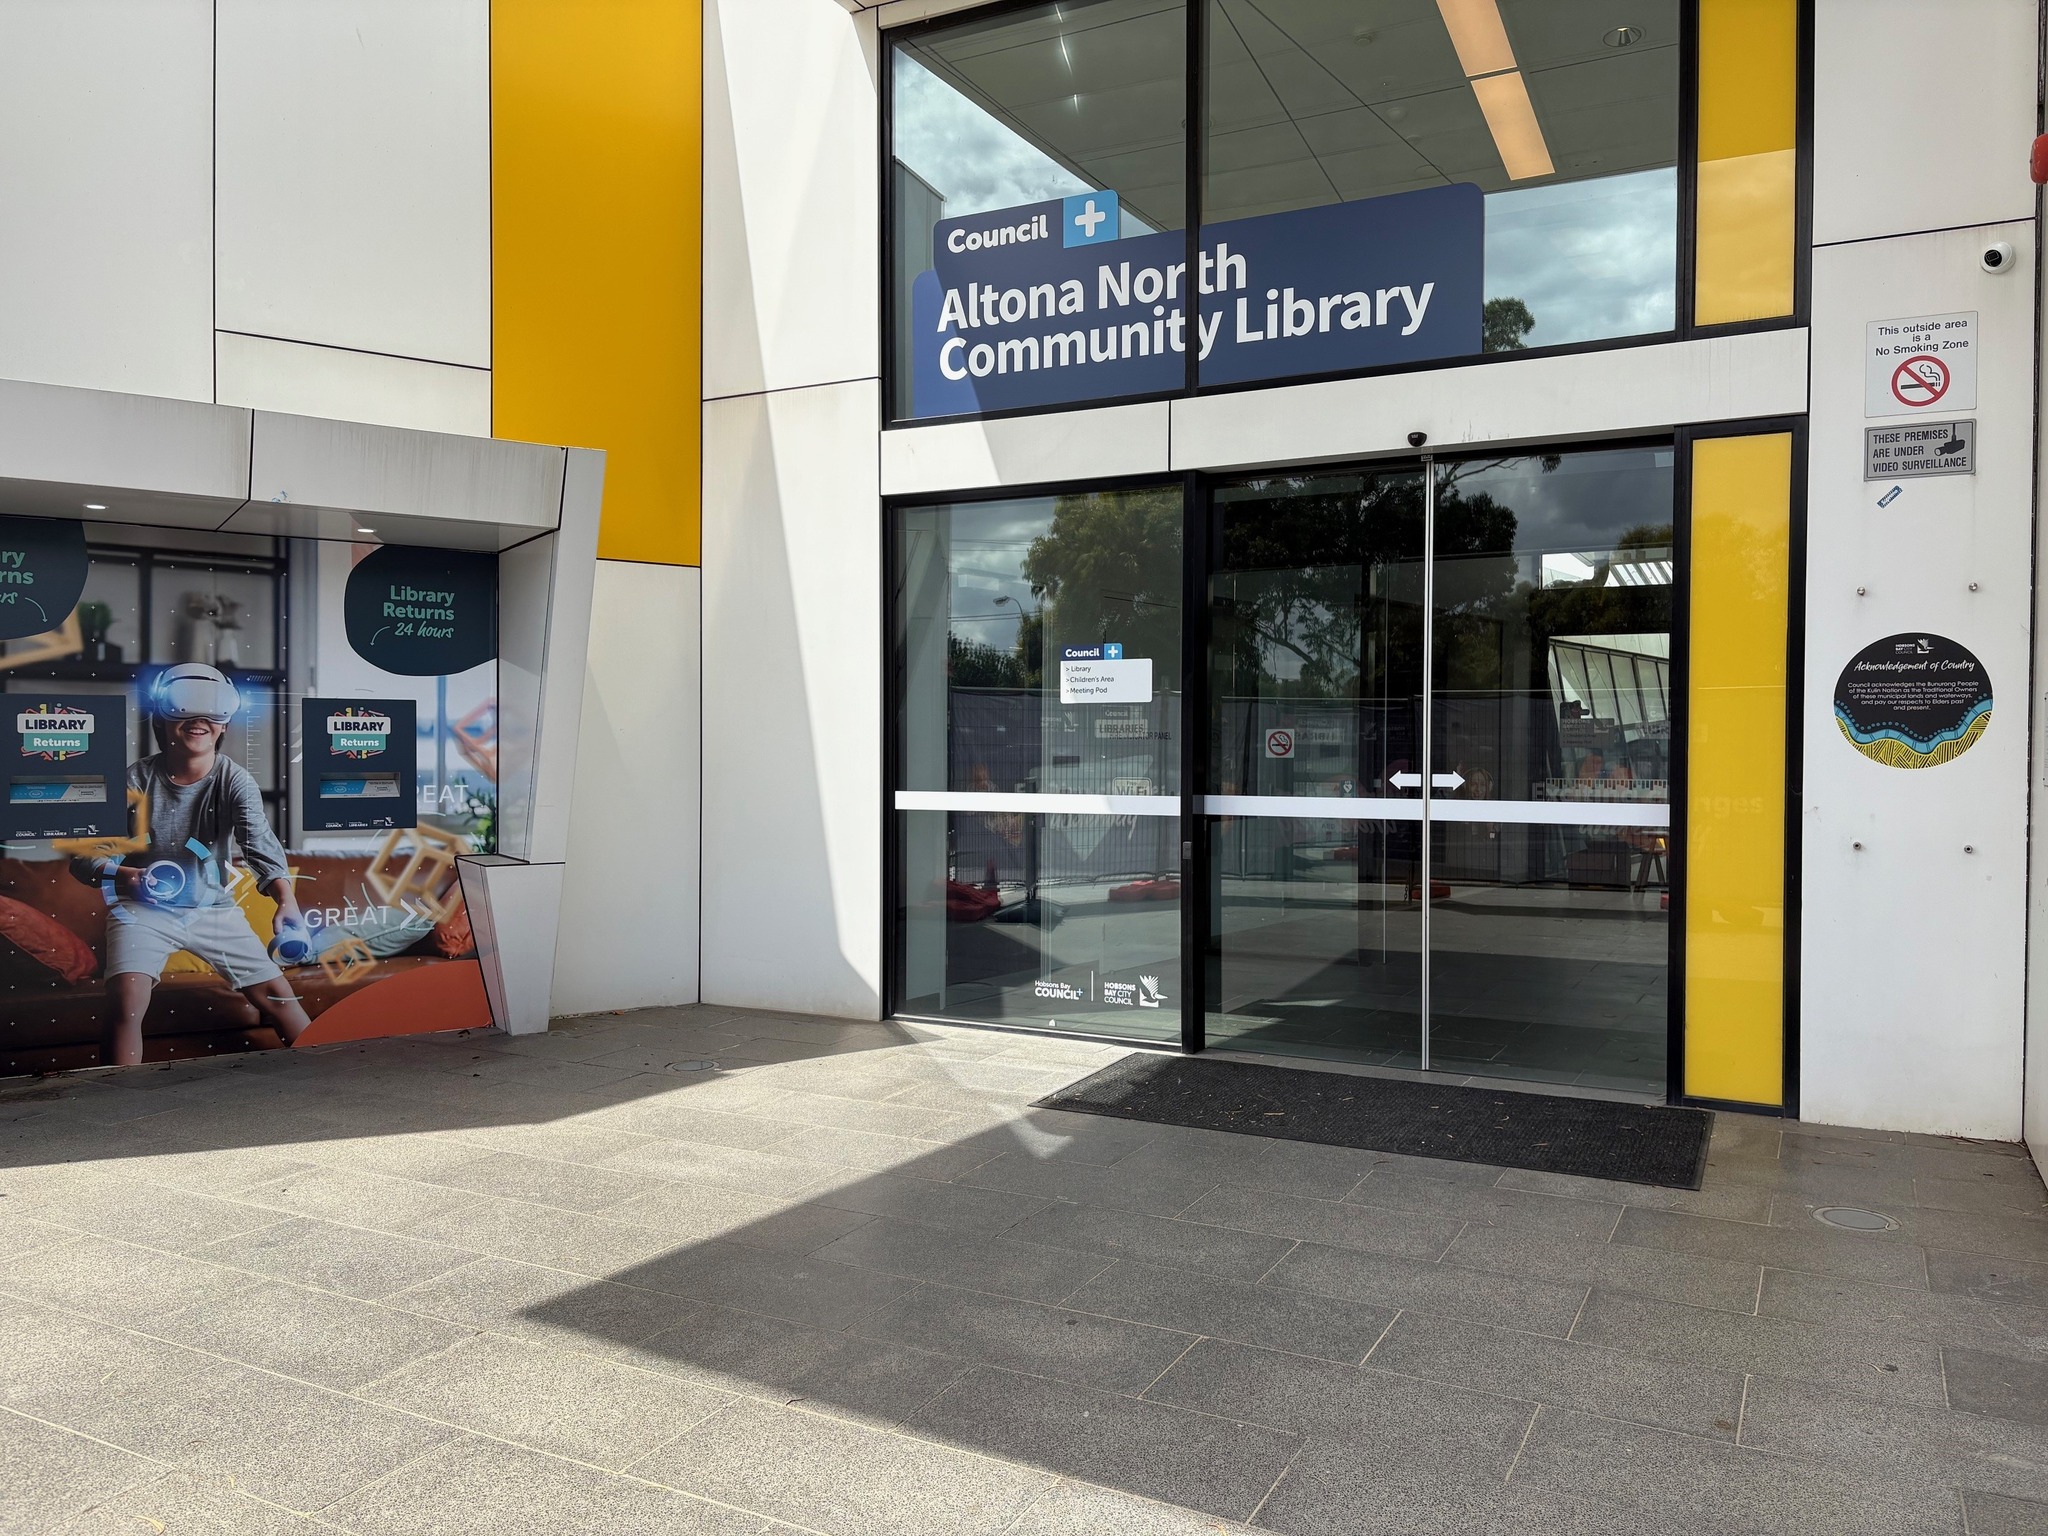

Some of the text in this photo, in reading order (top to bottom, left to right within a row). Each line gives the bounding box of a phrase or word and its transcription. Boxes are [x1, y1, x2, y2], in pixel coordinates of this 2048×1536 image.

[948, 214, 1048, 253] Council
[936, 243, 1246, 333] Altona North
[939, 282, 1435, 380] Community Library
[1878, 320, 1967, 336] This outside area
[1912, 334, 1920, 342] is
[1876, 340, 1968, 356] No Smoking Zone
[1874, 429, 1948, 444] THESE PREMISES
[1873, 446, 1924, 458] ARE UNDER
[1873, 457, 1966, 472] VIDEO SURVEILLANCE
[390, 585, 455, 607] Library
[383, 602, 455, 620] Returns
[395, 621, 454, 638] 24 hours
[1065, 648, 1100, 657] Council
[1854, 660, 1975, 673] Acknowledgement of Country
[1070, 687, 1094, 695] Meeting
[25, 719, 86, 730] LIBRARY
[334, 721, 384, 731] LIBRARY
[33, 738, 80, 746] Returns
[340, 738, 379, 746] Returns
[416, 784, 468, 803] EAT
[304, 905, 392, 928] GREAT
[1035, 980, 1071, 991] Hobsons Bay
[1104, 982, 1136, 991] HOBSONS
[1118, 990, 1132, 998] CITY
[1104, 997, 1133, 1005] COUNCIL
